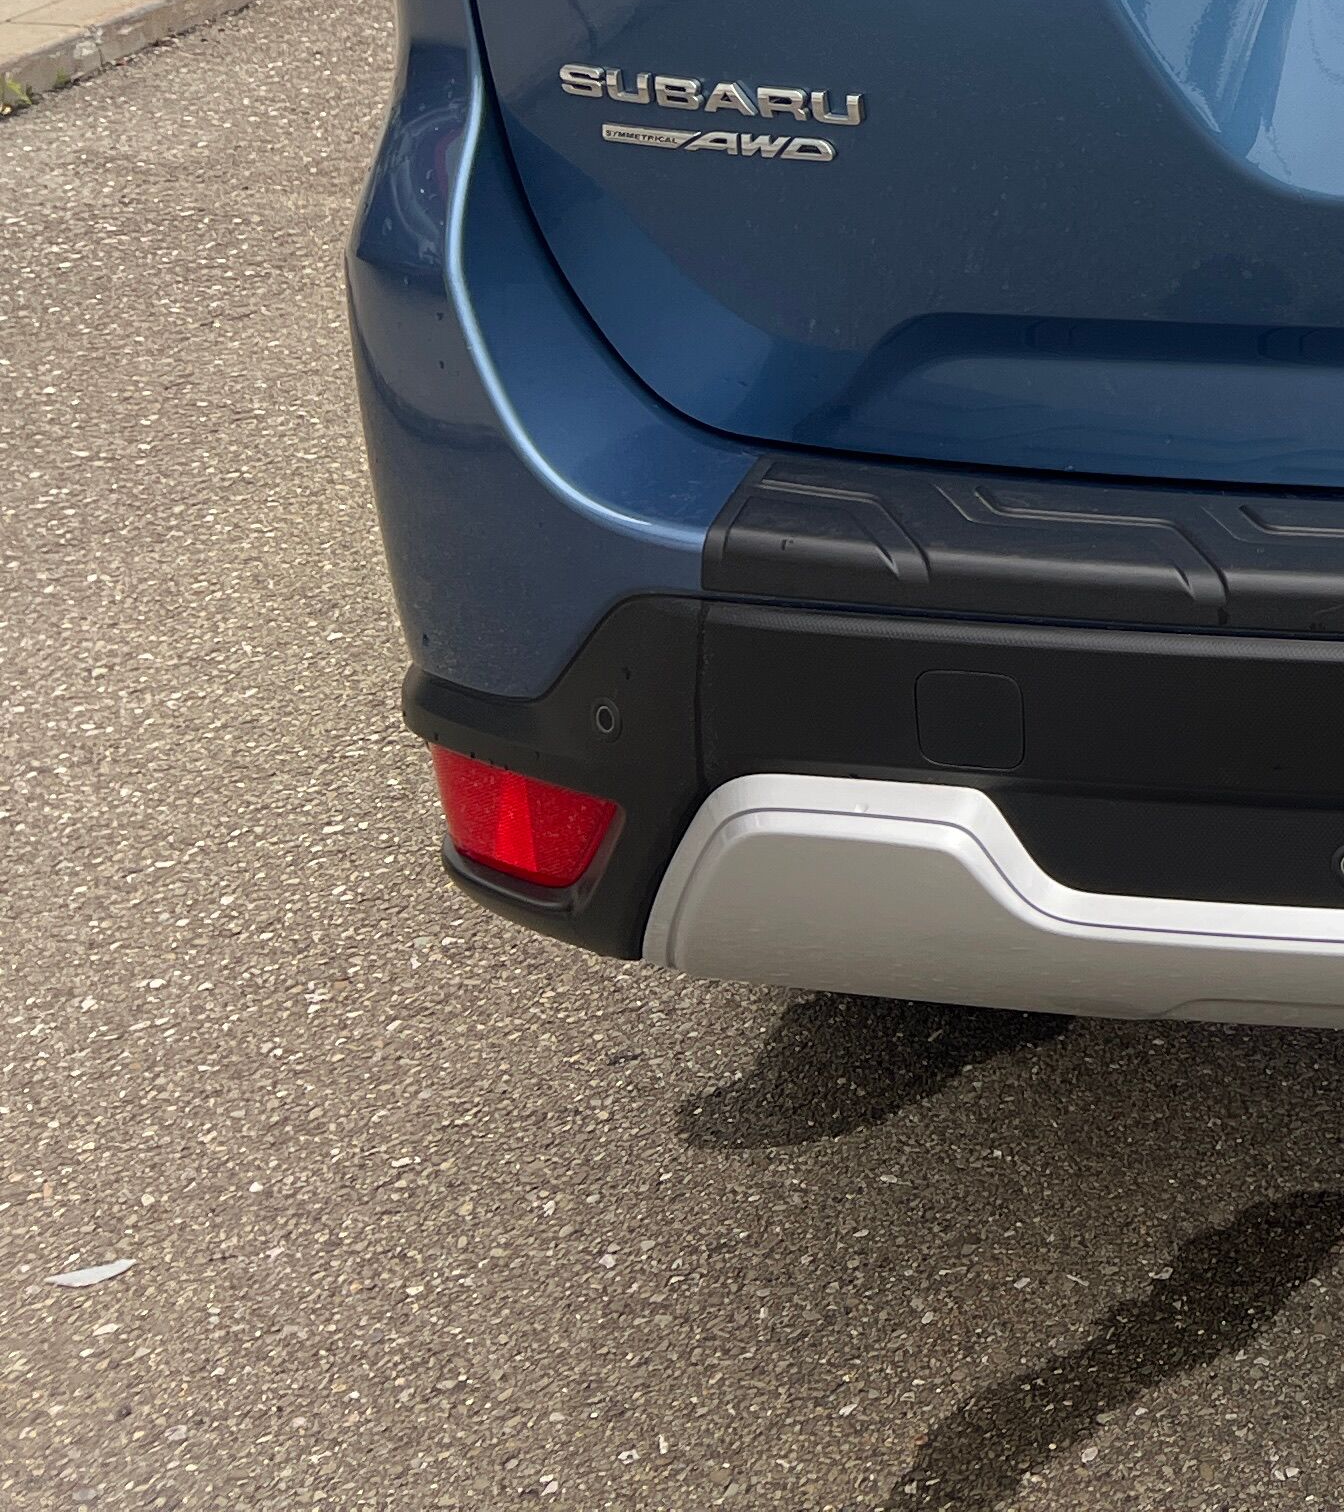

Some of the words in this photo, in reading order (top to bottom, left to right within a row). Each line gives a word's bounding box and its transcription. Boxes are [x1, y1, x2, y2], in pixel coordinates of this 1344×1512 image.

[559, 63, 865, 126] SUBARU
[605, 129, 678, 144] SYMMETRICAL
[683, 131, 837, 162] AWD
